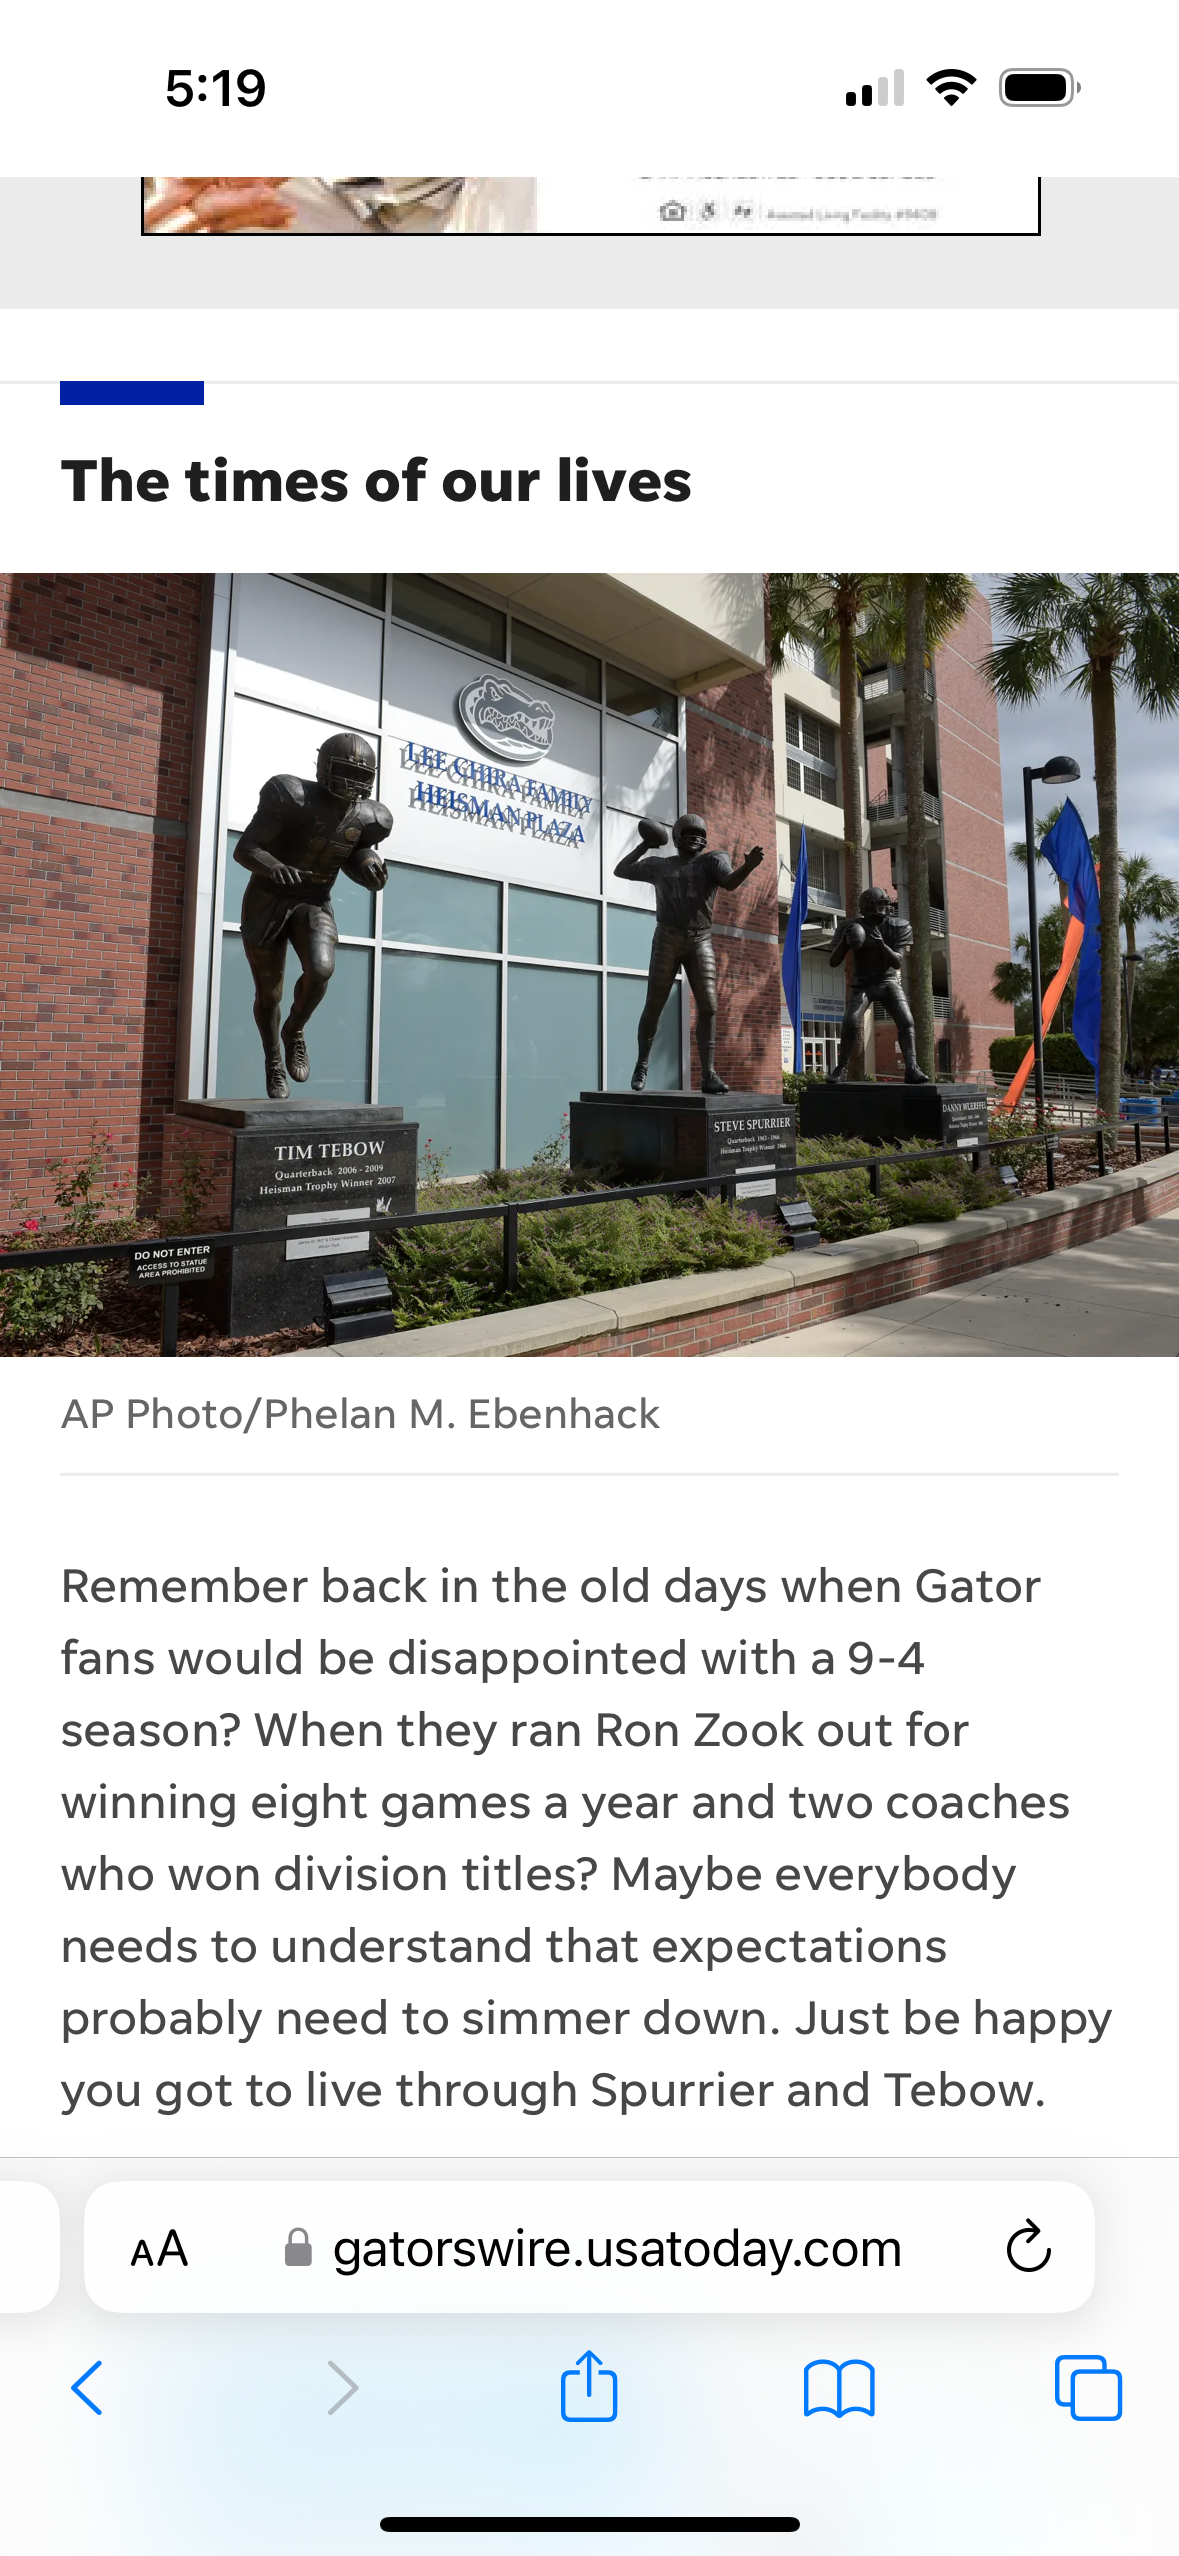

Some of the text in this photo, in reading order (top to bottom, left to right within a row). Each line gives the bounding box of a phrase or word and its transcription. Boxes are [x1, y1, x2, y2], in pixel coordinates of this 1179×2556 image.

[166, 68, 266, 108] 5:19
[60, 455, 692, 503] The times of our lives
[407, 741, 593, 814] LEE CHIRA FAMILY
[416, 781, 585, 843] HEISMAN PLAZA
[714, 1117, 791, 1133] STEVE SPURRIER
[943, 1103, 962, 1113] DANNY
[275, 1140, 386, 1161] TIM TEBOW
[275, 1168, 333, 1181] Quarterback
[337, 1166, 358, 1175] 2006
[364, 1164, 384, 1173] 2009
[259, 1176, 396, 1195] Heisman Trophy Winner 2007
[134, 1245, 210, 1260] DO NOT ENTER
[137, 1262, 167, 1271] ACCESS
[181, 1258, 208, 1267] STATUE
[139, 1266, 205, 1279] AREA PROHIBITED
[60, 1396, 661, 1434] AP Photo/Phelan M. Ebenhack
[63, 1566, 1042, 1612] Remember back in the old days when Gator
[60, 1637, 925, 1684] fans would be disappointed with a 9-4
[61, 1709, 970, 1756] season? When they ran Ron Zook out for
[60, 1782, 1070, 1828] winning eight games a year and two coaches
[60, 1854, 1017, 1900] who won division titles? Maybe everybody
[63, 1926, 947, 1972] needs to understand that expectations
[63, 1998, 1113, 2044] probably need to simmer down. Just be happy
[60, 2070, 1044, 2116] you got to live through Spurrier and Tebow.
[333, 2227, 902, 2277] gatorswire.usatoday.com
